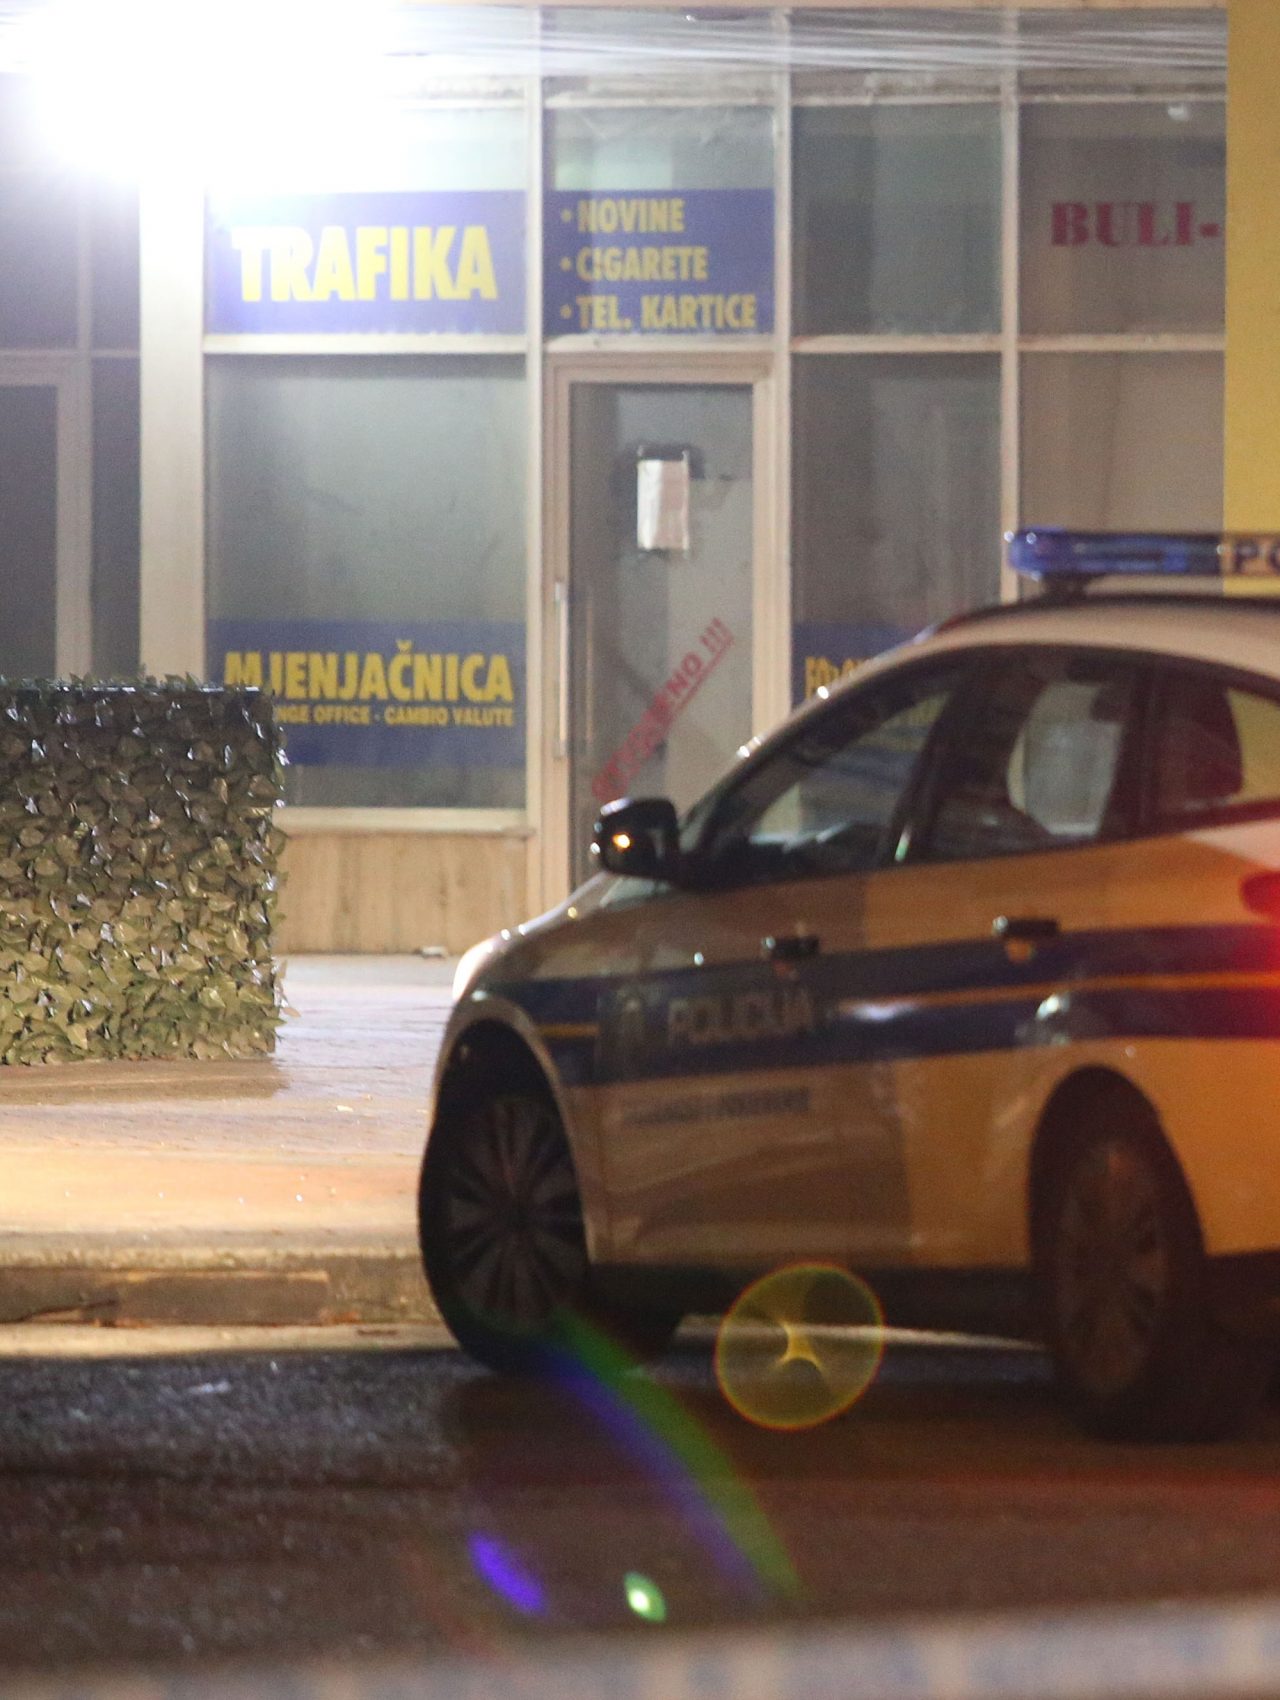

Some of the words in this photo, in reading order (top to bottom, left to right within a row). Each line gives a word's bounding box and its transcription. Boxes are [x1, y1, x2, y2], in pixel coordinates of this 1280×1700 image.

[577, 197, 685, 233] NOVINE
[232, 226, 498, 303] TRAFIKA
[576, 245, 709, 281] CIGARETE
[576, 294, 632, 329] TEL.
[640, 294, 757, 329] KARTICE
[223, 639, 515, 702] MJENJAČNICA
[314, 706, 370, 725] OFFICE
[384, 706, 448, 726] CAMBIO
[453, 707, 514, 727] VALUTE
